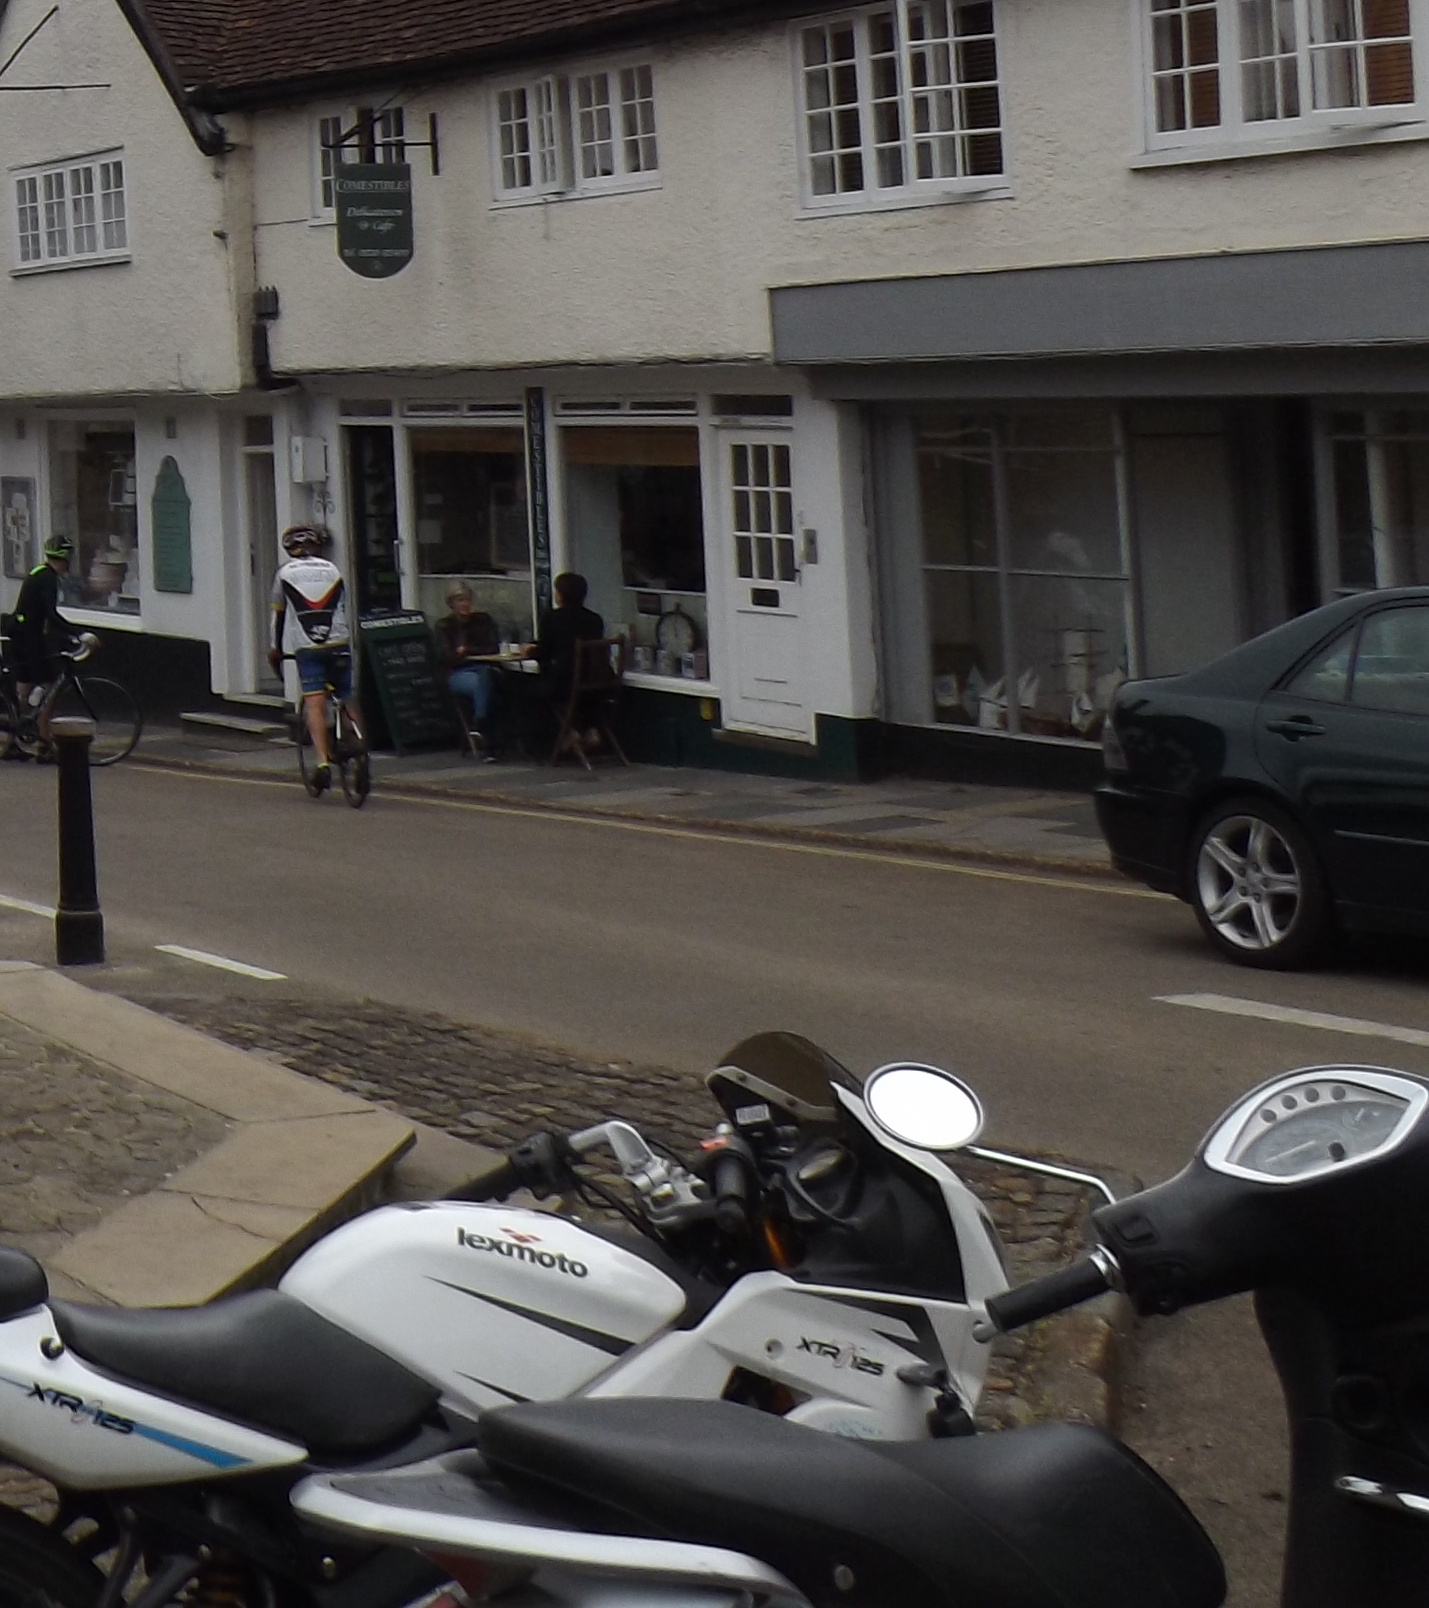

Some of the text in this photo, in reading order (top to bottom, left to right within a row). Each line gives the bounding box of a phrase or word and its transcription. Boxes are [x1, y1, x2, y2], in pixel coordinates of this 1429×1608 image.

[337, 179, 410, 192] COMESTIBLES
[456, 1225, 589, 1278] lexmoto
[796, 1336, 840, 1359] XTR
[852, 1355, 884, 1375] 125
[27, 1381, 83, 1413] XTR
